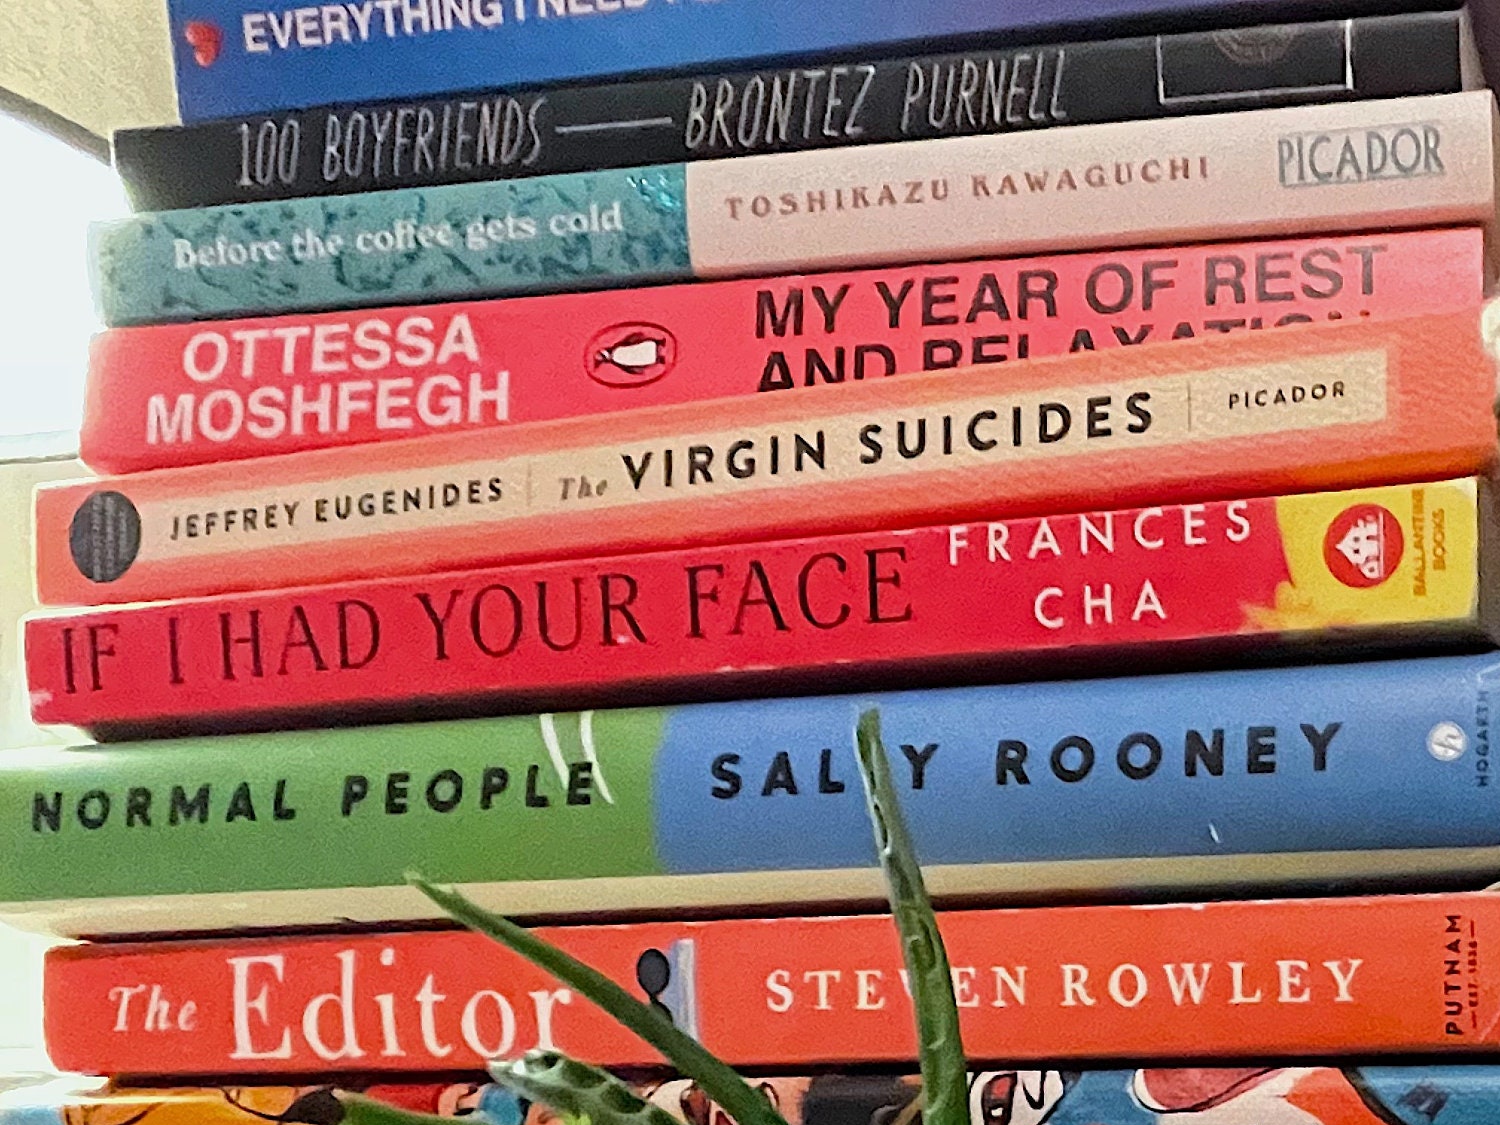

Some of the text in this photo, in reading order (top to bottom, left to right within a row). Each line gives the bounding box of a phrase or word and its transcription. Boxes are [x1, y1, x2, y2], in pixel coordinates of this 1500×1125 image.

[242, 0, 503, 52] EVERYTHING
[240, 49, 1070, 188] 100 BOYFRIENDS BRONTEZ PURNELL
[725, 154, 1212, 221] TOSHIKAZU KAWAGUCHI
[1277, 126, 1448, 188] PICADOR
[173, 202, 625, 271] Before the coffee gets cold
[756, 244, 1389, 339] MY YEAR OF REST
[183, 313, 481, 384] OTTESSA
[145, 371, 511, 446] MOSHFEGH
[1227, 380, 1348, 411] PICADOR
[558, 391, 1154, 502] The VIRGIN SUICIDES
[171, 503, 299, 542] JEFFREY
[314, 477, 504, 525] EUGENIDES
[949, 501, 1252, 567] FRANCES
[1432, 508, 1447, 572] BOOKS
[60, 544, 914, 695] IF I HAD YOUR FACE
[1033, 579, 1168, 630] CHA
[711, 721, 1344, 800] SALY ROONEY
[1475, 690, 1490, 788] HOGARTH
[31, 760, 594, 833] NORMAL PEOPLE
[109, 946, 573, 1061] The Editor
[766, 956, 1366, 1013] STEEN ROWLEY
[1444, 915, 1464, 1036] PUTNAM
